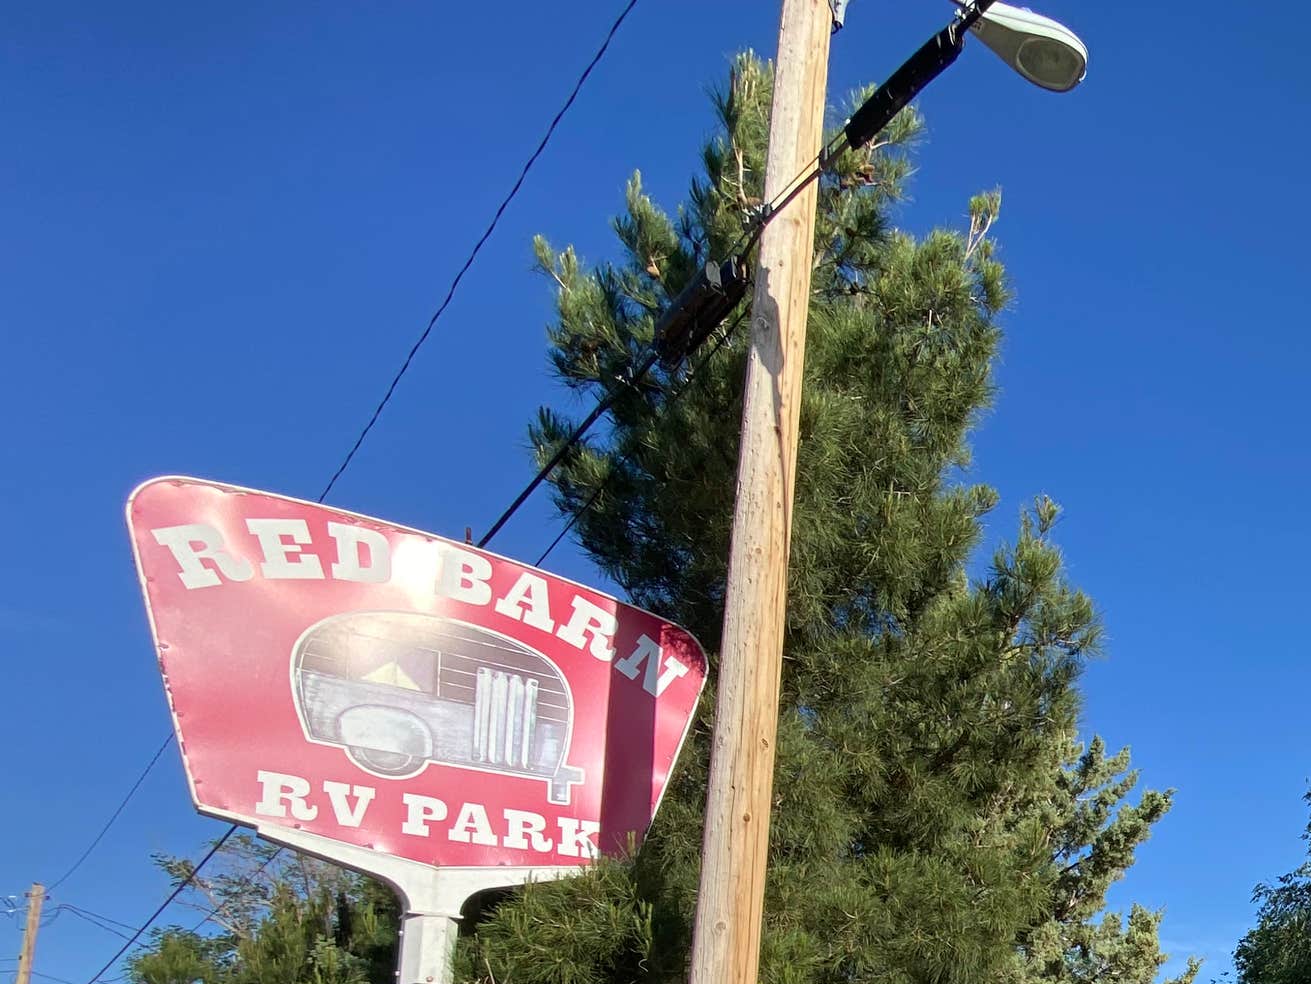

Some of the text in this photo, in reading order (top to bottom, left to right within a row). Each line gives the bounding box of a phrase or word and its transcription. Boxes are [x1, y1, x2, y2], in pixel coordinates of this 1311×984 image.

[152, 519, 687, 698] RED BARN
[256, 771, 601, 859] RV PARK
